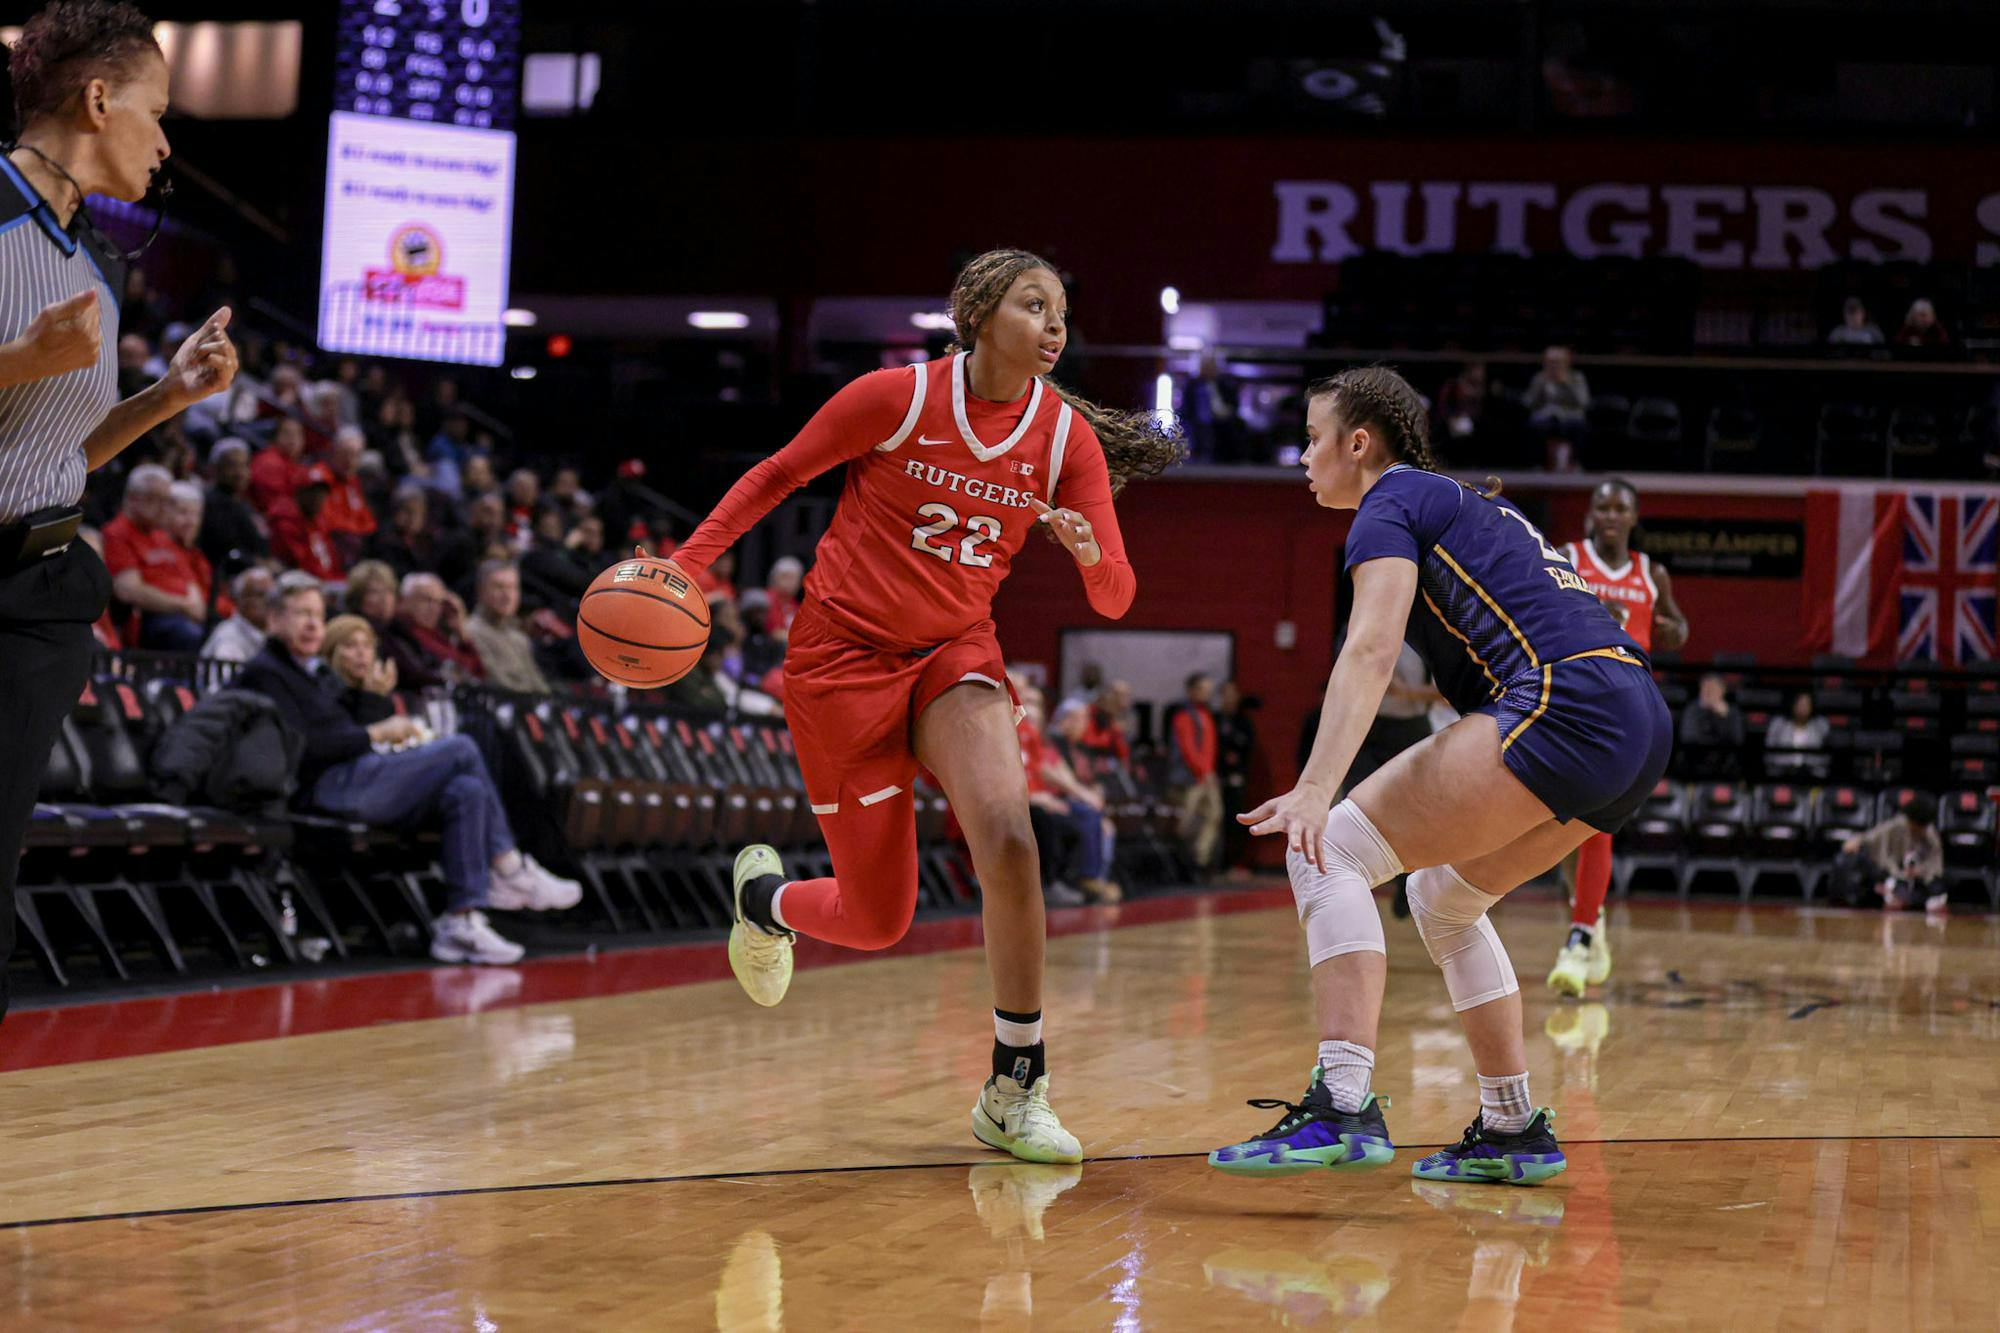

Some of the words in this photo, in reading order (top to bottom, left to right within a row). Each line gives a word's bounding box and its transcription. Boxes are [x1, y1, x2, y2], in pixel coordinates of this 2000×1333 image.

[1271, 180, 1933, 268] RUTGERS
[904, 459, 1034, 508] RUTGERS
[911, 502, 1003, 568] 22
[616, 564, 688, 594] ELITE
